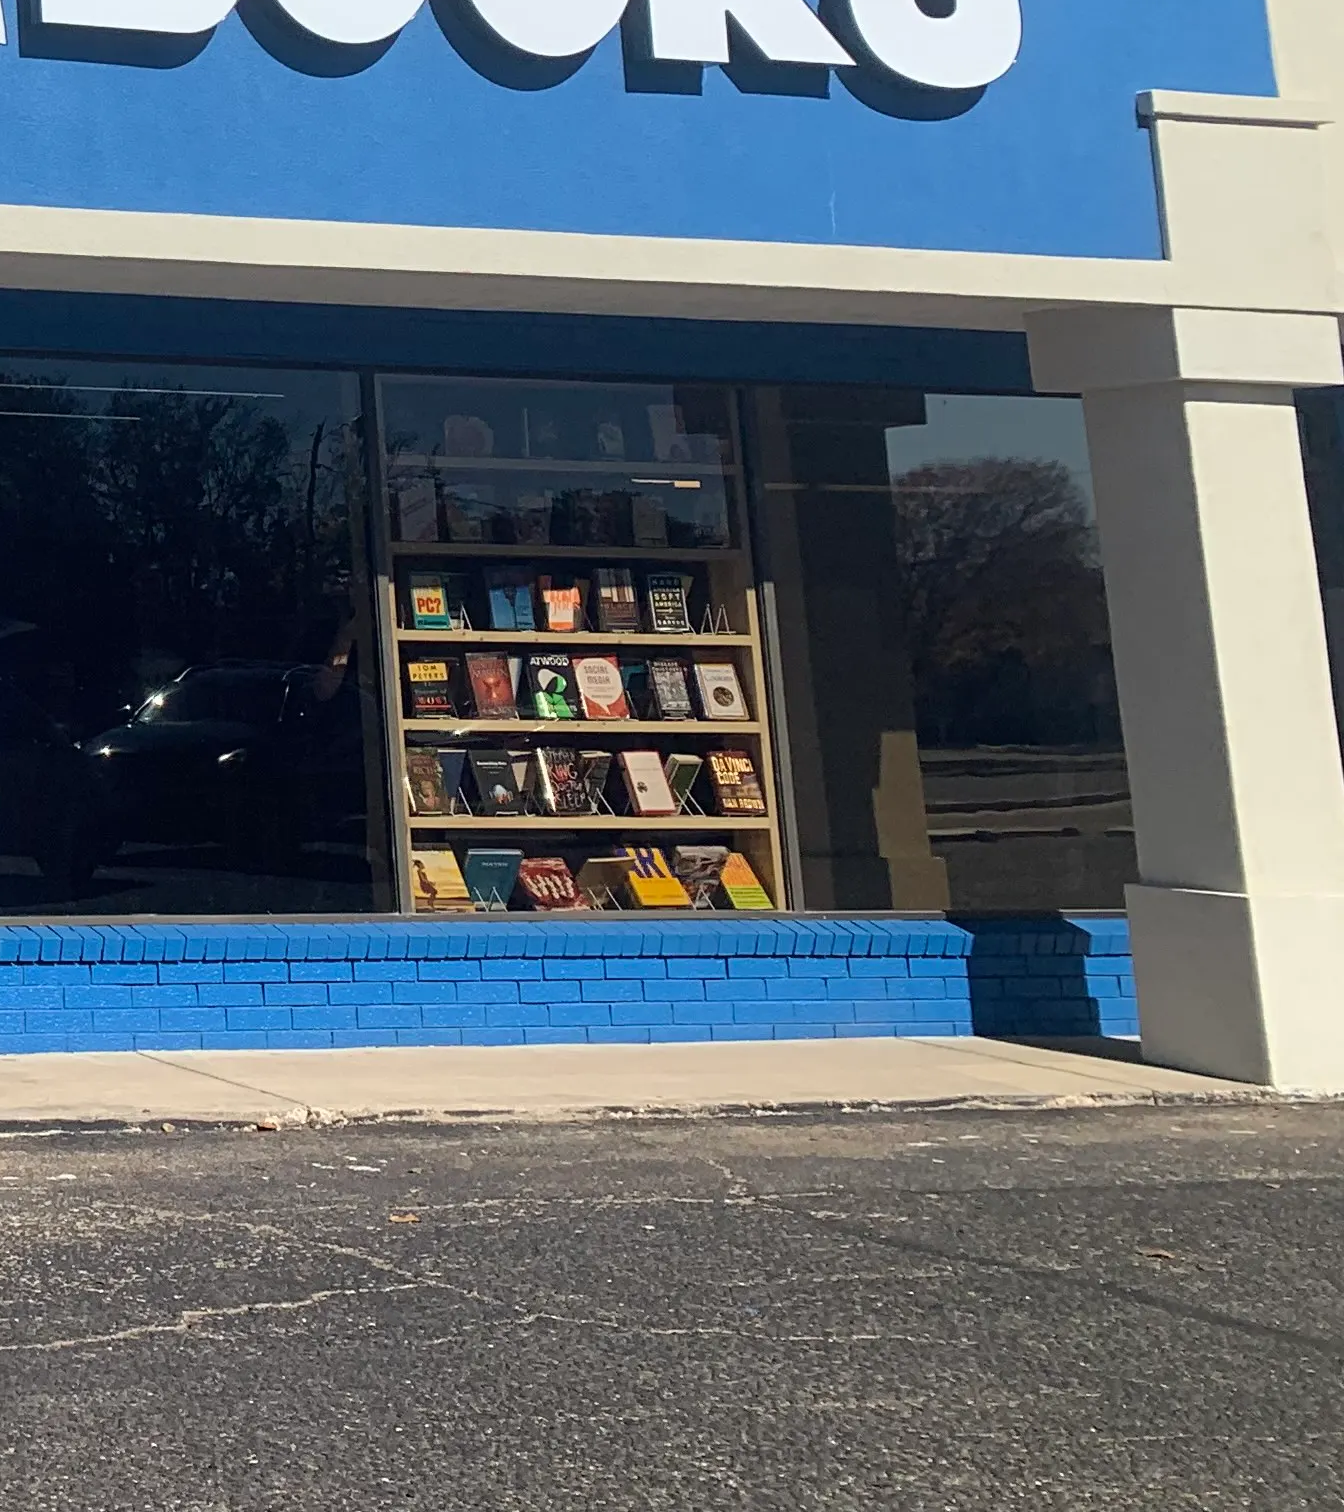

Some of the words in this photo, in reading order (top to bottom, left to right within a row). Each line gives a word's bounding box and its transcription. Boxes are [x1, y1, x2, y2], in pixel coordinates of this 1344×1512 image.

[416, 597, 442, 614] PC?
[530, 656, 569, 667] ATWOOD
[412, 672, 444, 680] PETERS
[716, 771, 742, 785] CODE
